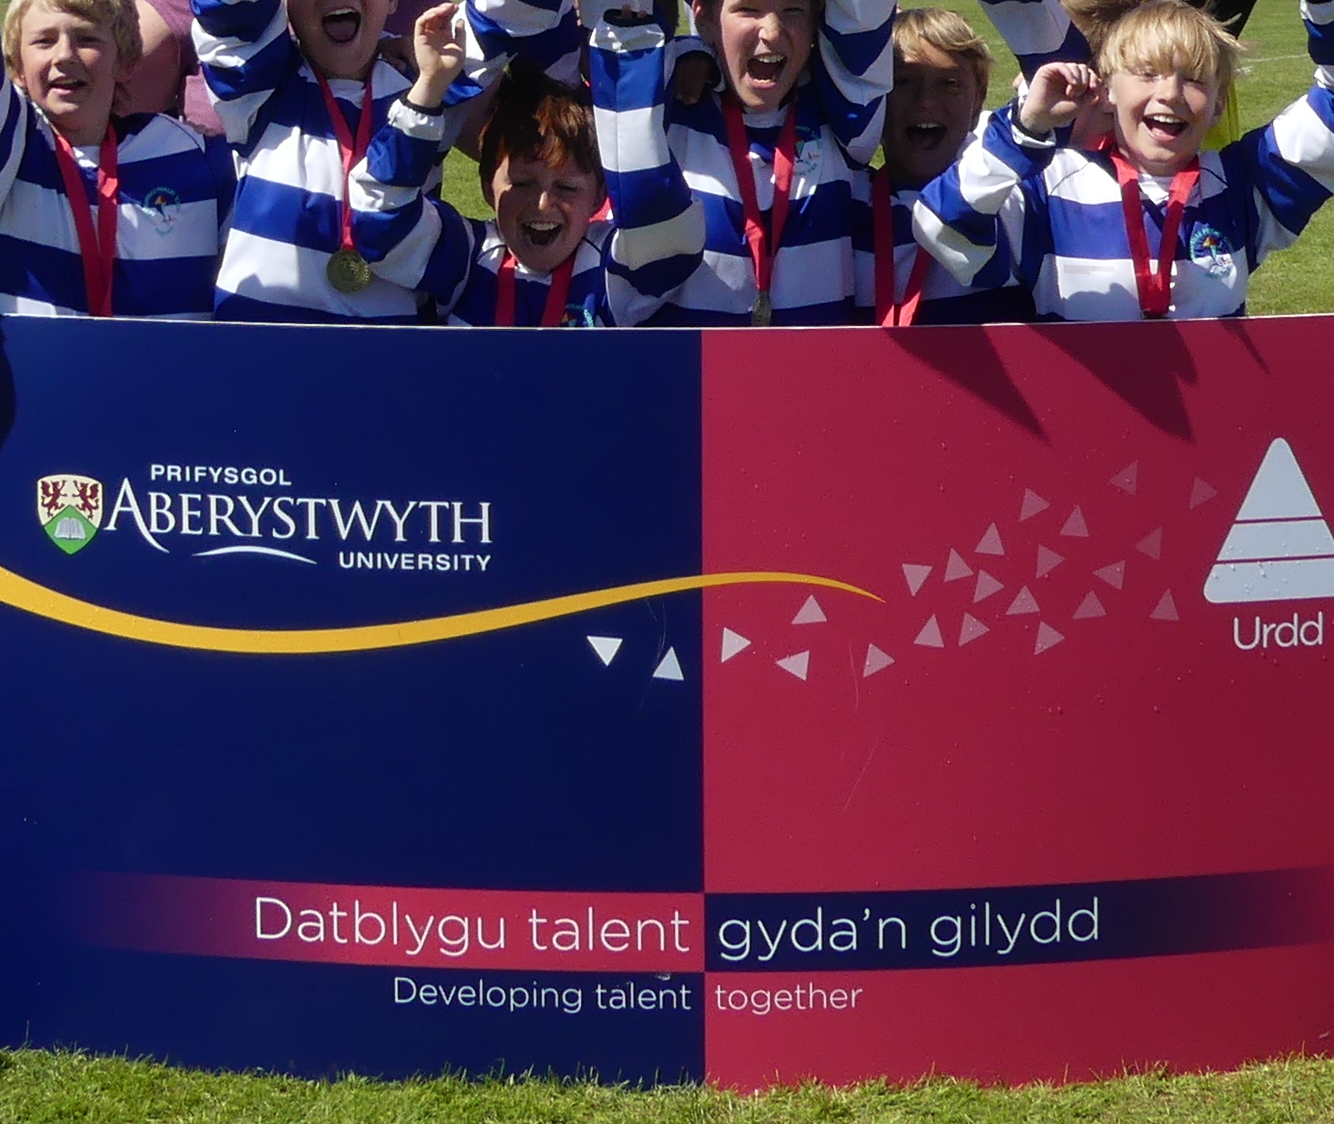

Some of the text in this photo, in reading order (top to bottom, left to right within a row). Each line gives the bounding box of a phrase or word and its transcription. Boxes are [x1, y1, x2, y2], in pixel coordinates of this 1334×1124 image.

[150, 464, 293, 487] PRIFYSGOL
[103, 477, 492, 554] ABERYSTWYTH
[339, 551, 492, 572] UNIVERSITY
[1233, 611, 1324, 651] Urdd
[255, 896, 1098, 961] Datblygu talent gyda'n gilydd
[394, 976, 863, 1015] Developing talent together
